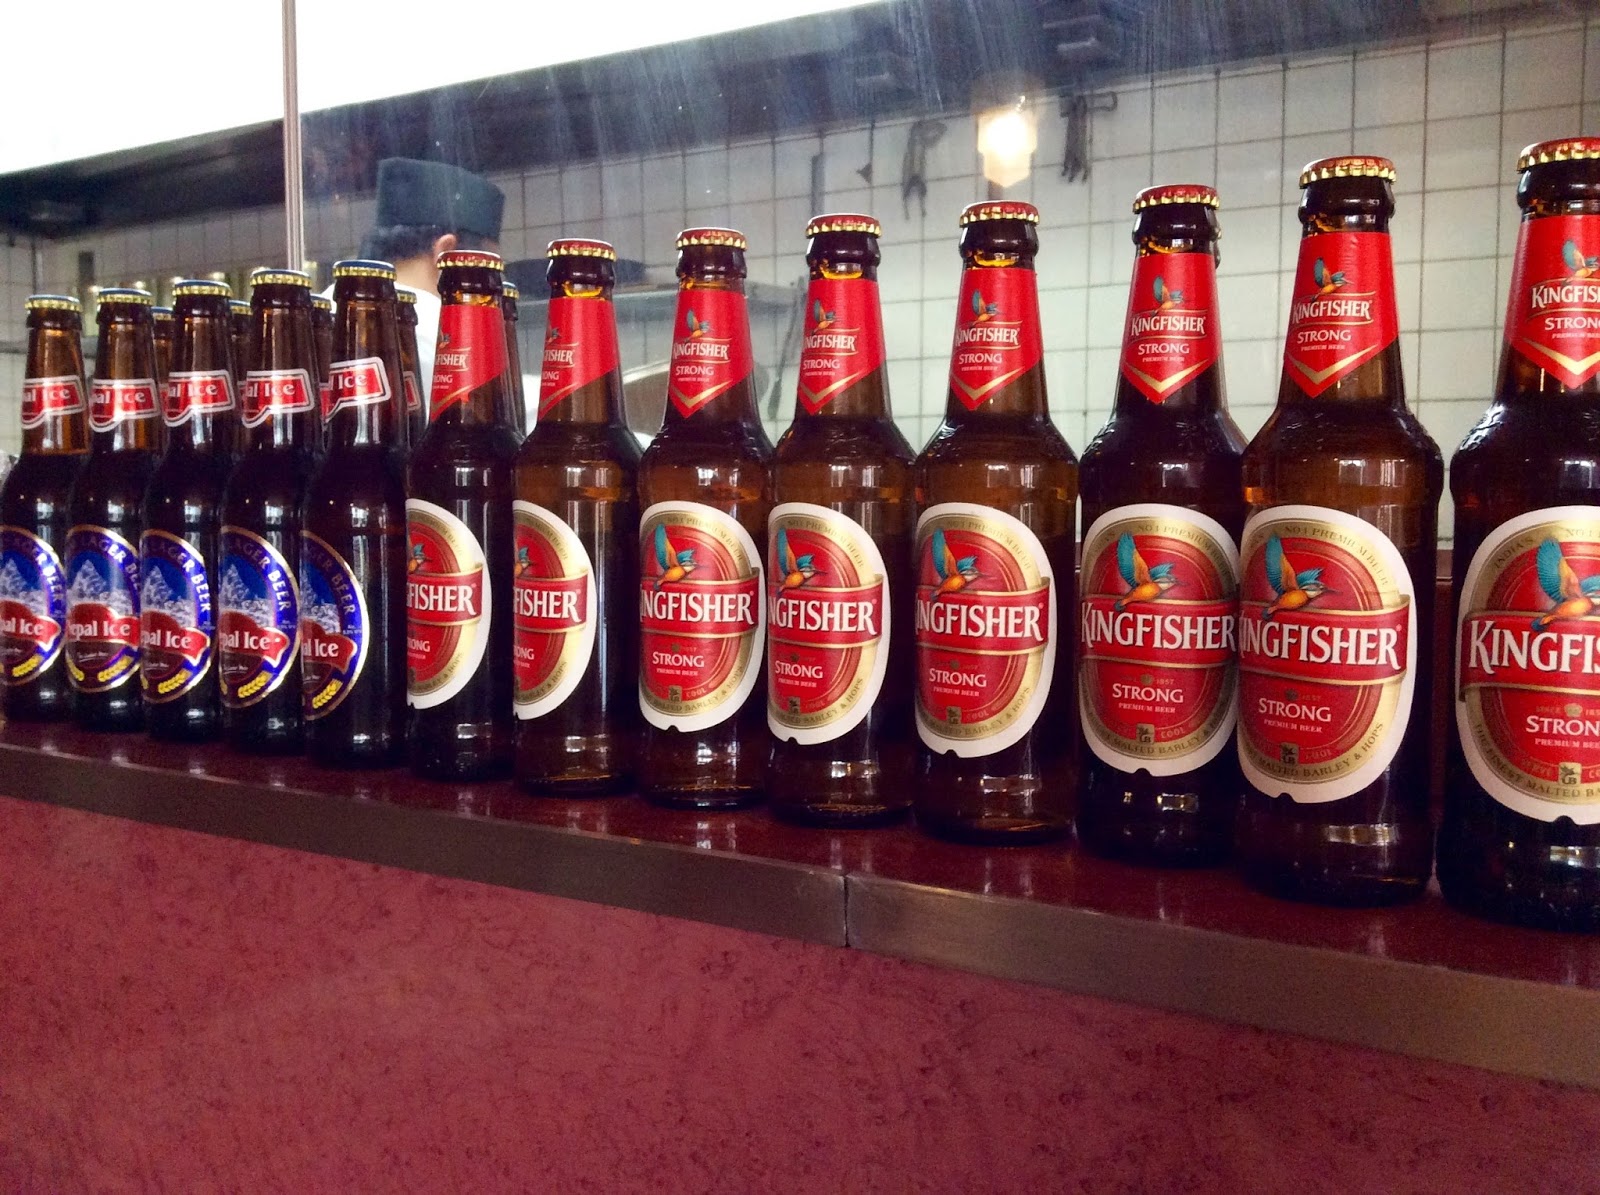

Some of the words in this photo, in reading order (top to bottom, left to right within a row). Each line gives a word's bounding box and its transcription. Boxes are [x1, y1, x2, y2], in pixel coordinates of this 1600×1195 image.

[1292, 300, 1371, 324] KINGFISHER
[1131, 315, 1205, 336] KINGFISHER
[1545, 317, 1600, 331] STRON
[1297, 329, 1351, 344] STRONG
[1138, 342, 1190, 355] STRONG
[803, 359, 841, 370] STRONG
[958, 353, 1003, 365] STRONG
[676, 365, 714, 376] STRONG
[188, 383, 218, 397] Ice
[265, 383, 296, 397] Ice
[338, 373, 368, 390] Ice
[268, 570, 292, 611] BEER
[331, 573, 356, 614] BEER
[513, 585, 582, 623] FISHER
[20, 618, 44, 635] Ice
[916, 593, 1044, 641] INGFISHER
[103, 621, 131, 637] Ice
[1081, 602, 1236, 652] KINGFISHER
[165, 630, 191, 649] Ice
[243, 631, 270, 650] Ice
[314, 638, 339, 657] Ice
[652, 651, 705, 667] STRONG
[775, 660, 824, 679] STRONG
[929, 667, 987, 687] STRONG
[1112, 683, 1184, 703] STRONG
[1258, 697, 1332, 722] STRONG
[1526, 715, 1600, 737] STRON
[1259, 757, 1299, 777] MALTED
[1303, 758, 1350, 777] BARLEY
[1354, 752, 1362, 761] &
[1362, 721, 1384, 753] HOPS
[1535, 738, 1580, 748] PREMIUM
[1582, 741, 1600, 749] BEE
[1526, 780, 1581, 798] MALTED
